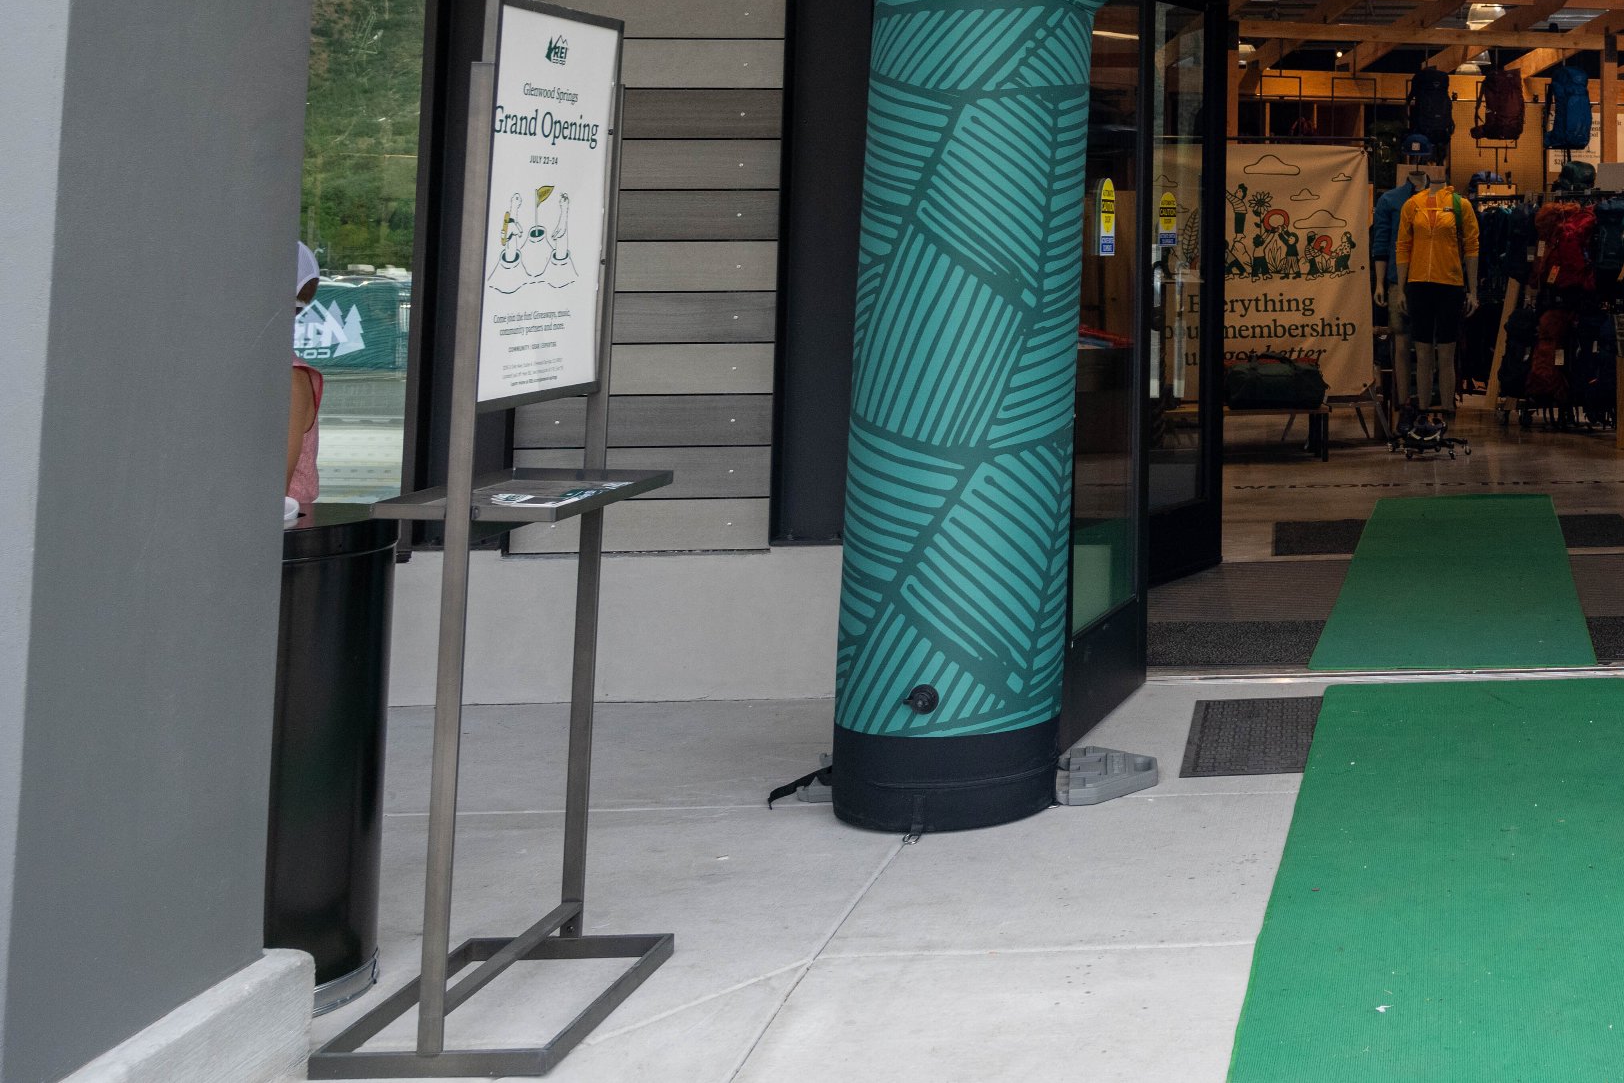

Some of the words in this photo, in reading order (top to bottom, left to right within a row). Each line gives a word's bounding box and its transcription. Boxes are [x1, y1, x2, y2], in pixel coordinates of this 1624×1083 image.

[523, 82, 556, 99] Glenwood
[556, 87, 579, 106] Springs
[494, 105, 539, 137] Grand
[541, 111, 599, 150] Opening
[529, 155, 543, 164] JULY
[1188, 293, 1315, 317] Erything
[1223, 317, 1356, 341] membership
